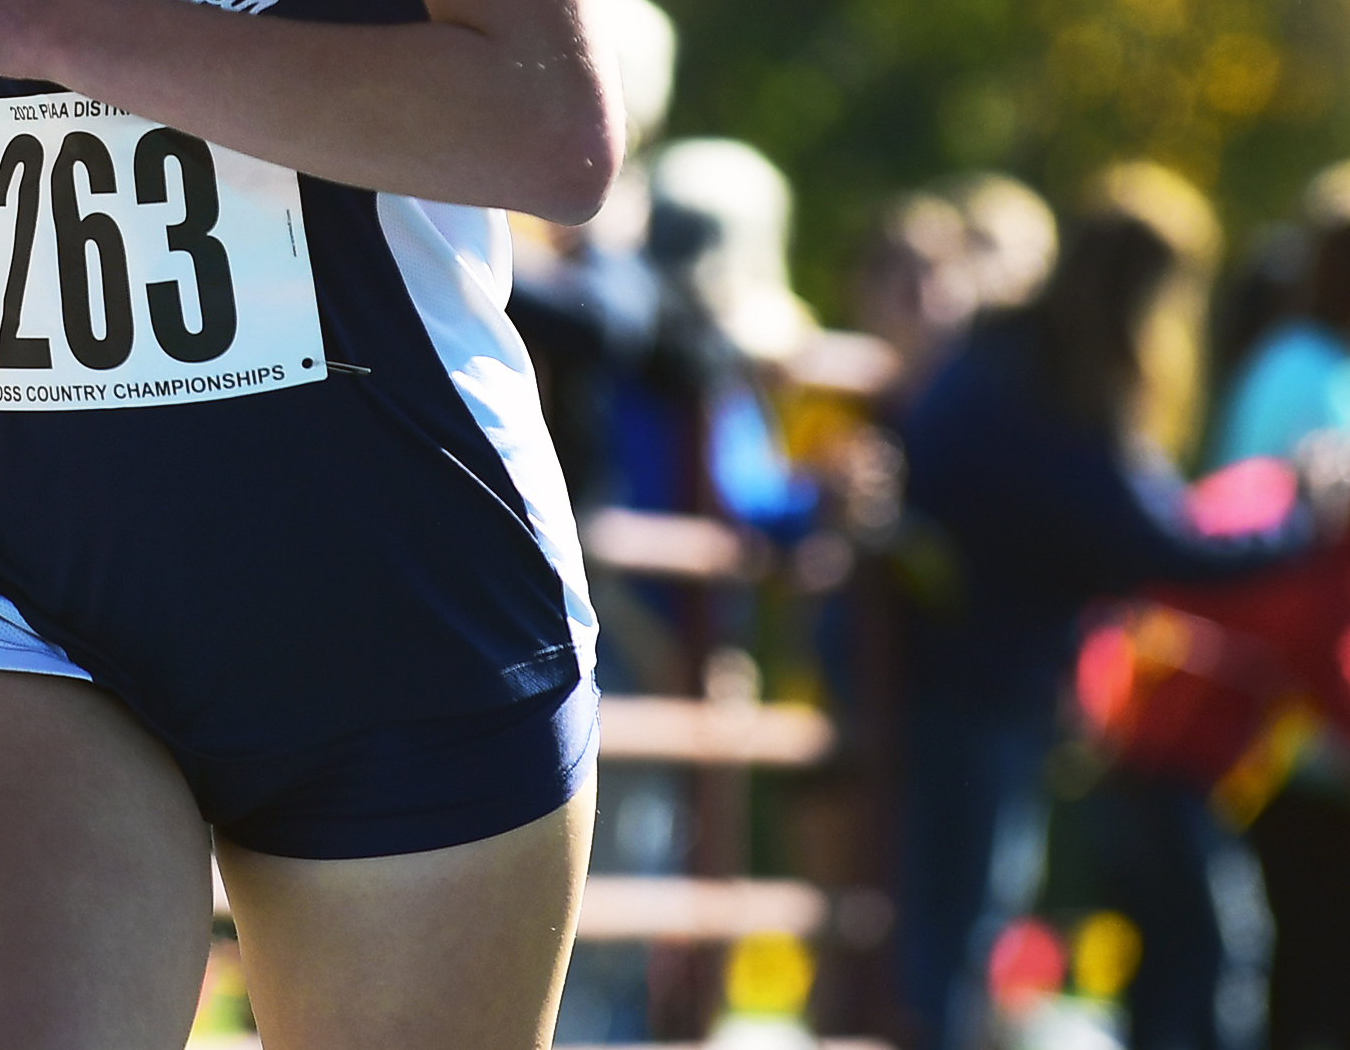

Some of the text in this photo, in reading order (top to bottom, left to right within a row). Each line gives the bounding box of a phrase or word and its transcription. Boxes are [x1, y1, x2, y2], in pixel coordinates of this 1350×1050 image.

[9, 105, 39, 121] 2022
[38, 102, 69, 120] PIAA
[25, 383, 108, 402] COUNTRY
[112, 364, 287, 400] CHAMPIONSHIPS
